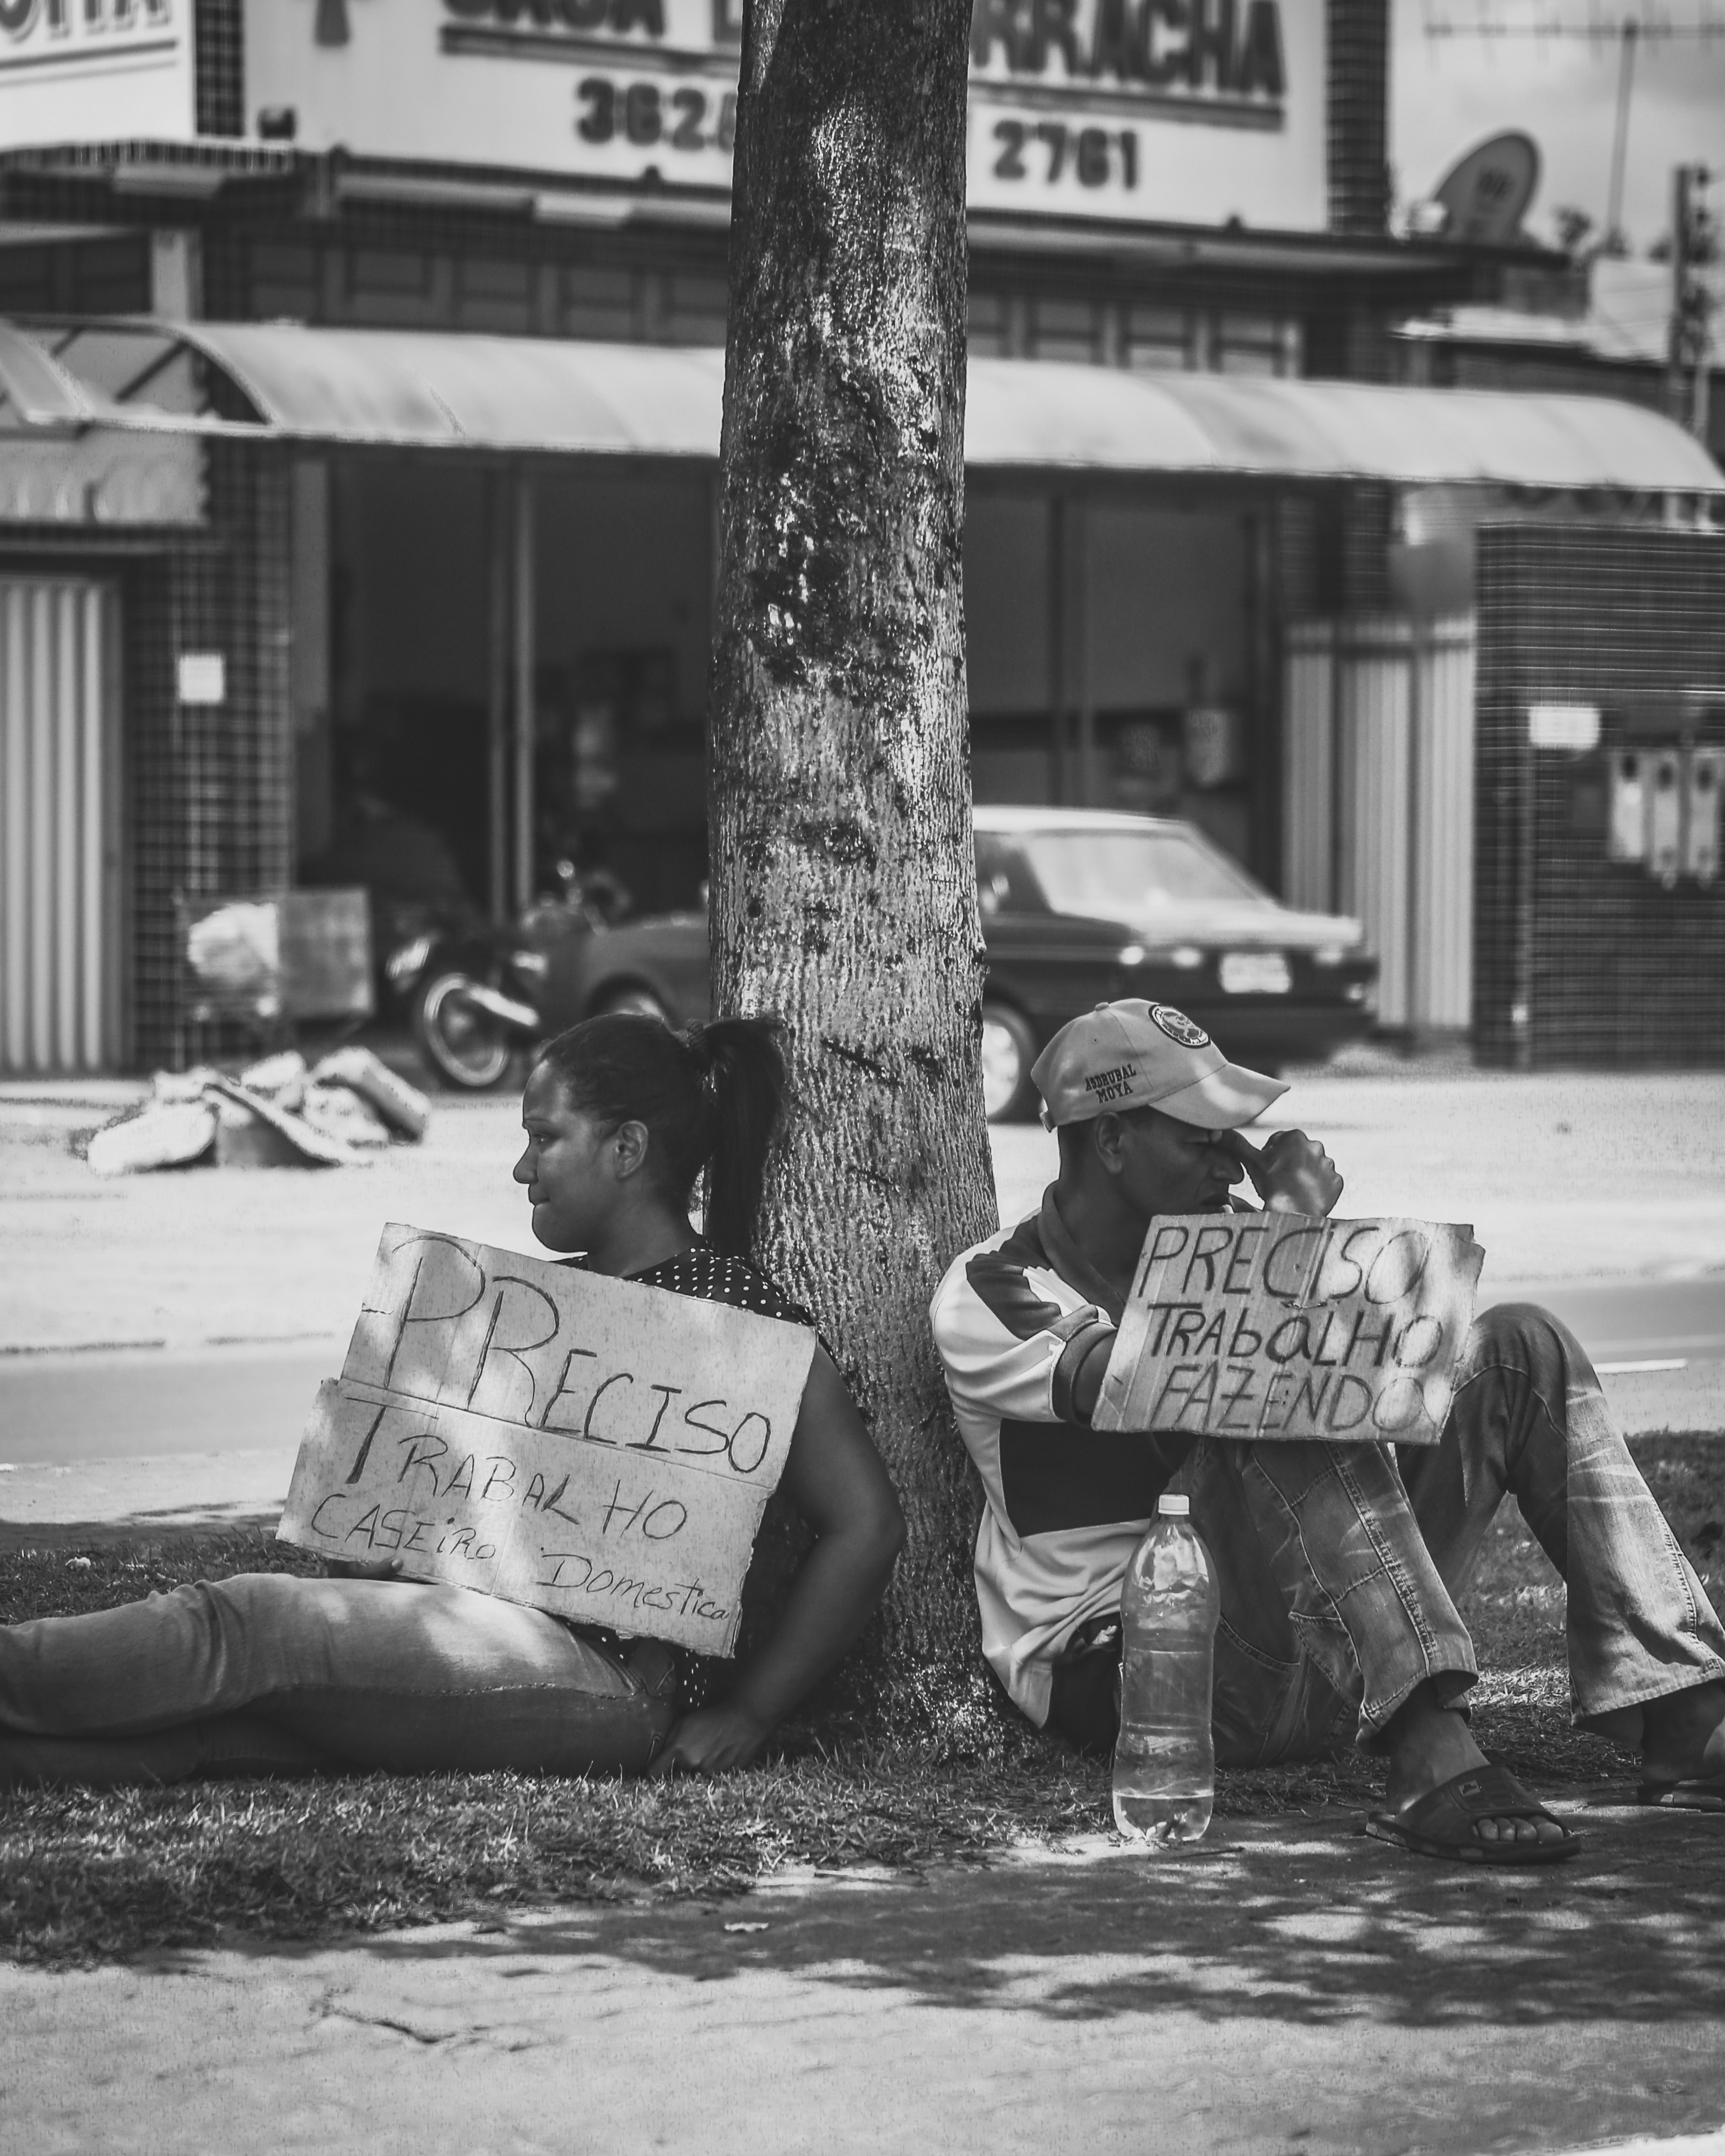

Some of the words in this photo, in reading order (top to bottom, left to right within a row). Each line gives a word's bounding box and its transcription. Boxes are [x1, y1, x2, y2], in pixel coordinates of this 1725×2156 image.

[970, 0, 1286, 94] RRACHA
[993, 119, 1138, 189] 2761
[1085, 1064, 1137, 1091] ASDRUBAL
[1095, 1081, 1133, 1103] MOYA
[1139, 1226, 1429, 1304] PRECISO
[384, 1236, 771, 1474] PRECISO
[1149, 1361, 1425, 1432] FAZENDO
